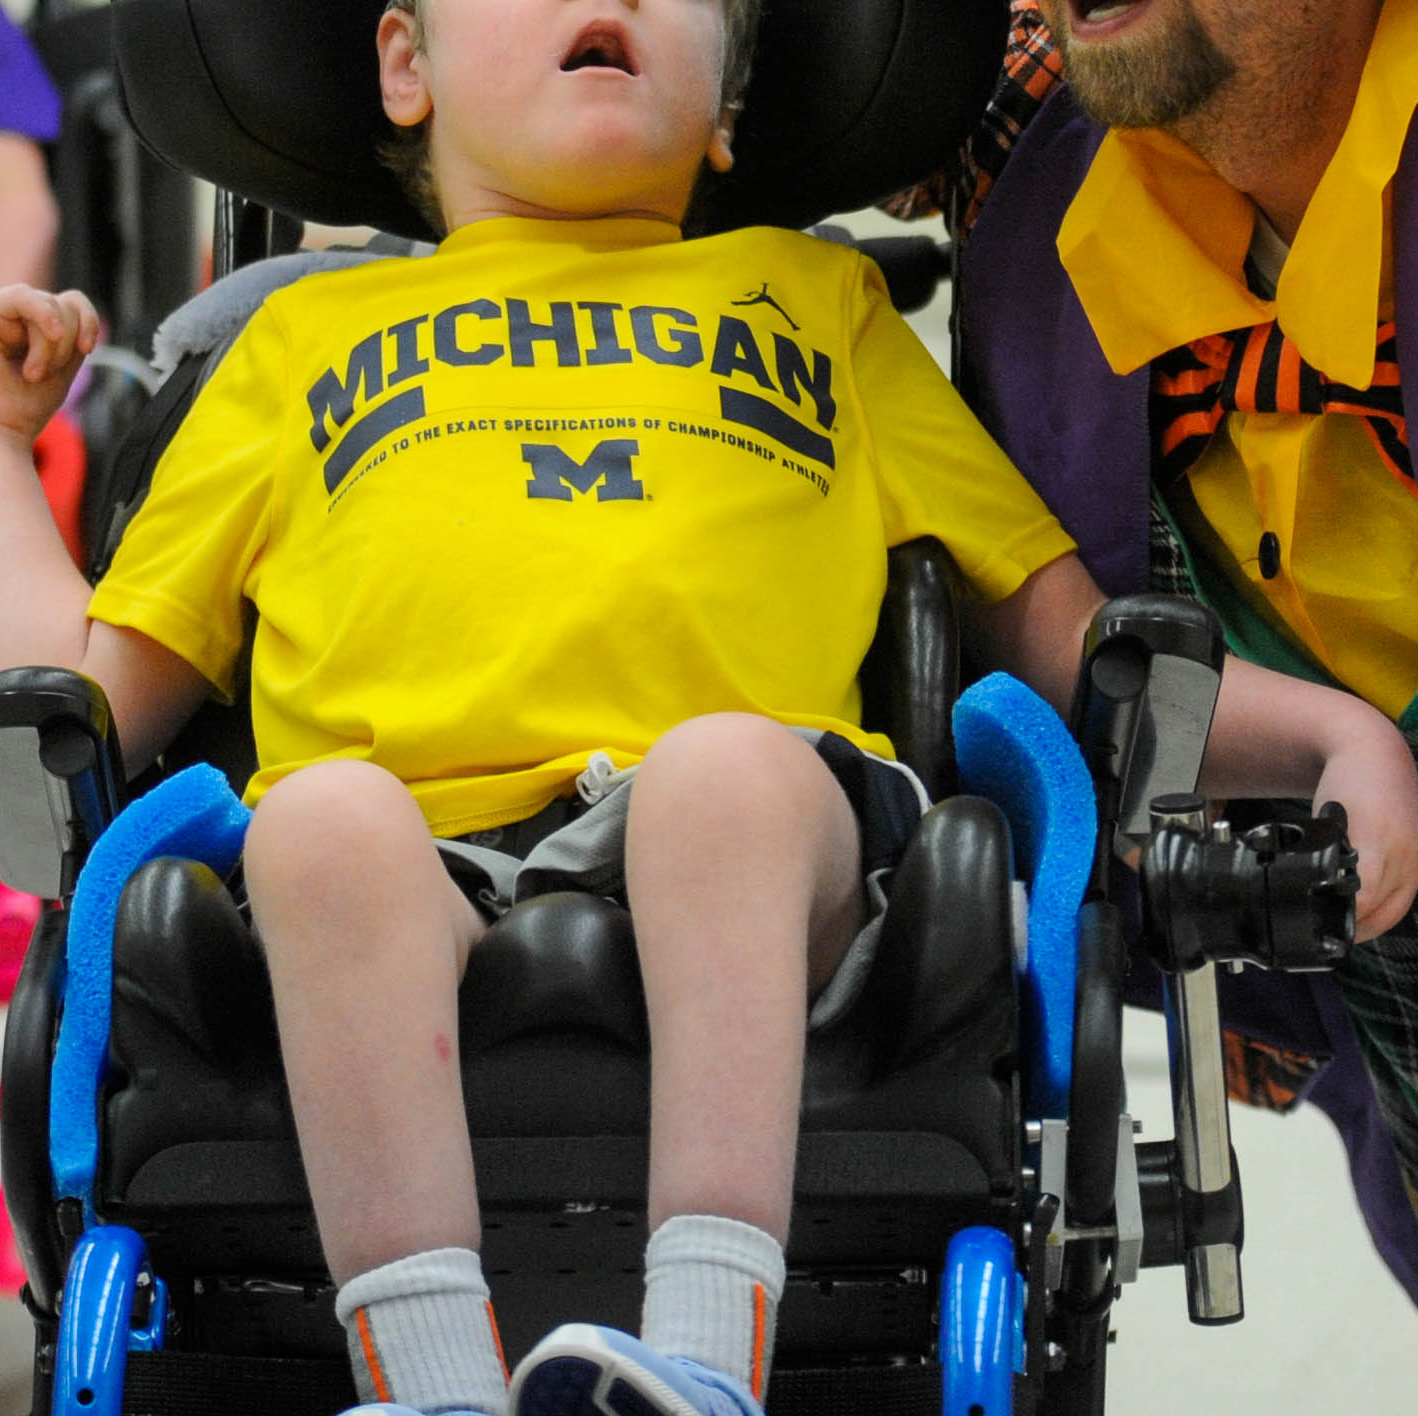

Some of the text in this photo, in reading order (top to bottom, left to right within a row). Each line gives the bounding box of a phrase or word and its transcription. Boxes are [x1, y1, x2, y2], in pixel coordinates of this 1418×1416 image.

[306, 297, 837, 453] MICHIGAN
[392, 437, 410, 453] TO
[414, 427, 442, 444] THE
[446, 419, 498, 435] EXACT
[503, 417, 637, 432] SPECIFICATIONS
[643, 418, 662, 431] OF
[667, 420, 777, 462] CHAMPIONSHIP
[520, 439, 644, 502] M
